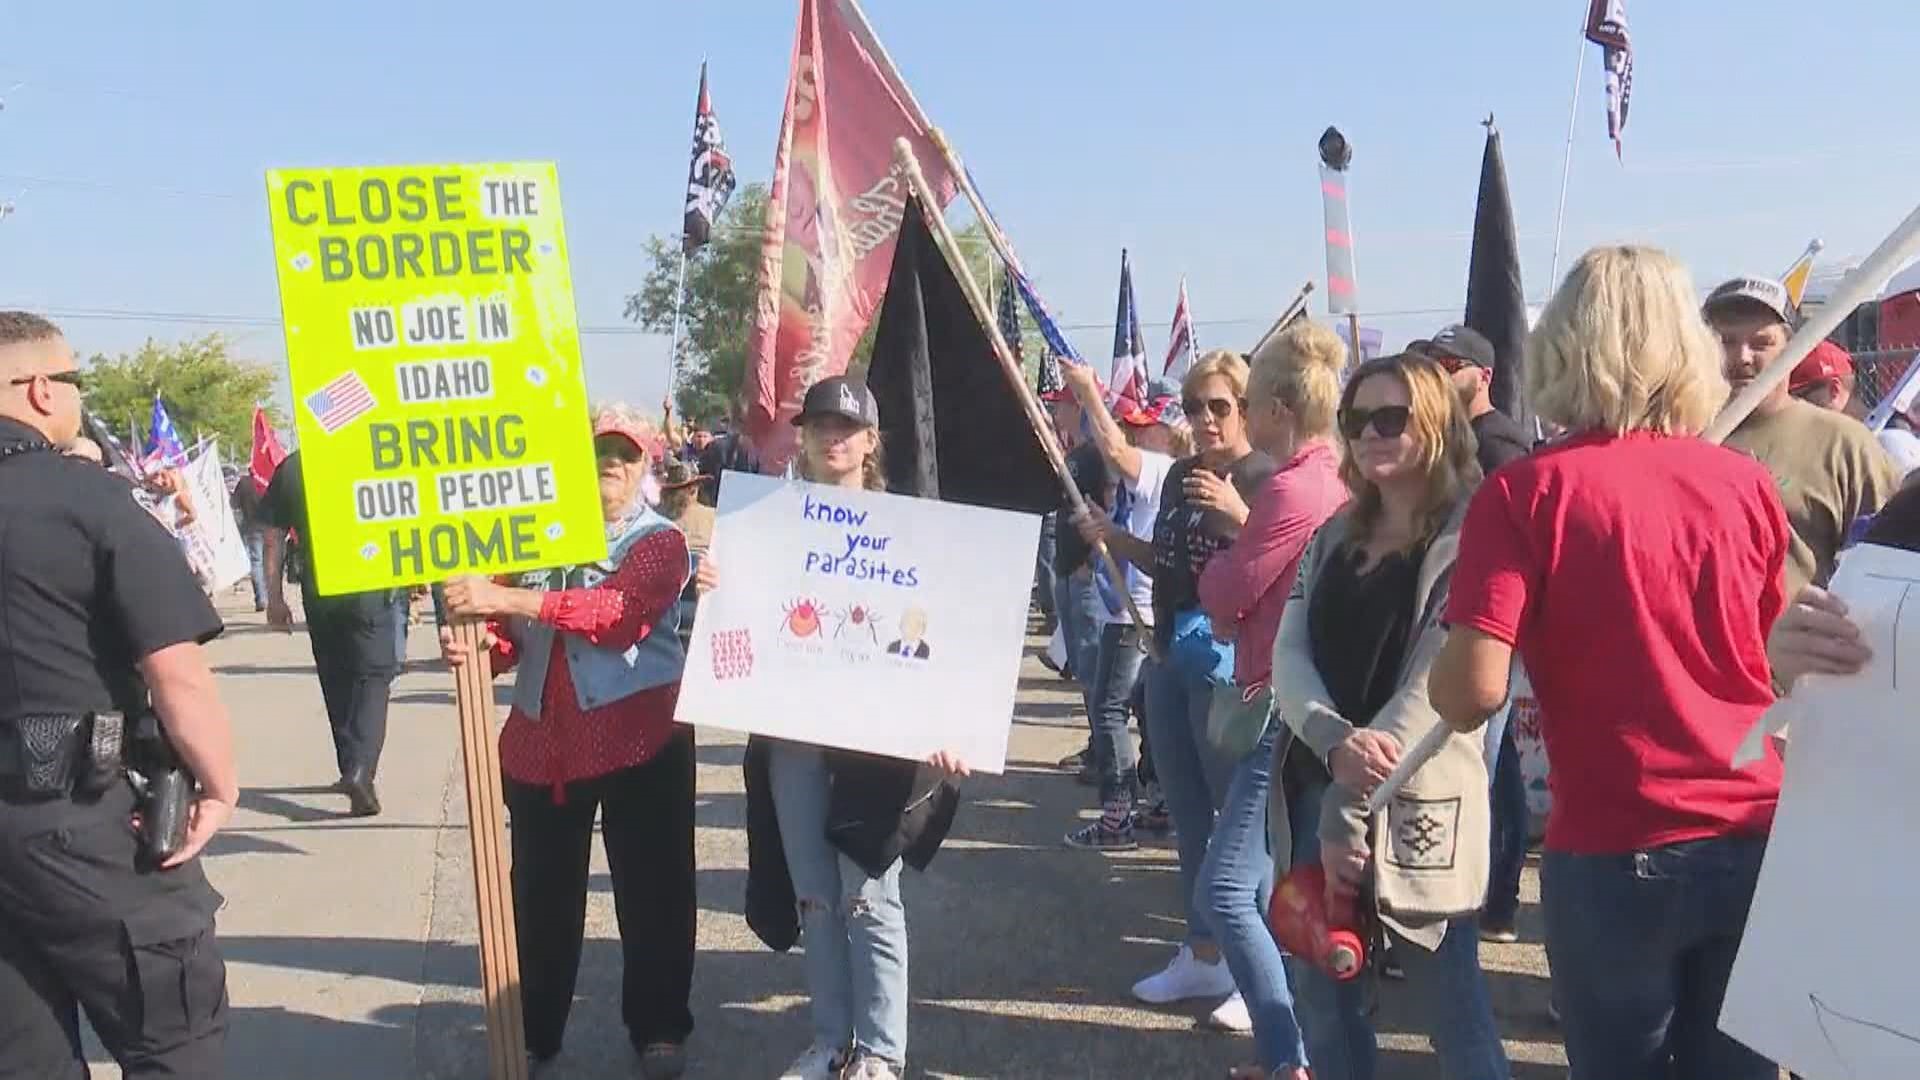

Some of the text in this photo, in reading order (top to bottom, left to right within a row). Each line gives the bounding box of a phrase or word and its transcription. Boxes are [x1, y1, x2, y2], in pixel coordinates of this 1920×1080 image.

[284, 175, 538, 226] CLOSE THE
[318, 229, 533, 283] BORDER
[353, 302, 510, 346] NO JOE IN
[400, 360, 490, 401] IDAHO
[369, 414, 527, 471] BRING
[357, 466, 554, 520] OUR PEOPLE
[803, 495, 868, 527] know
[389, 515, 541, 577] HOME
[846, 533, 891, 561] your
